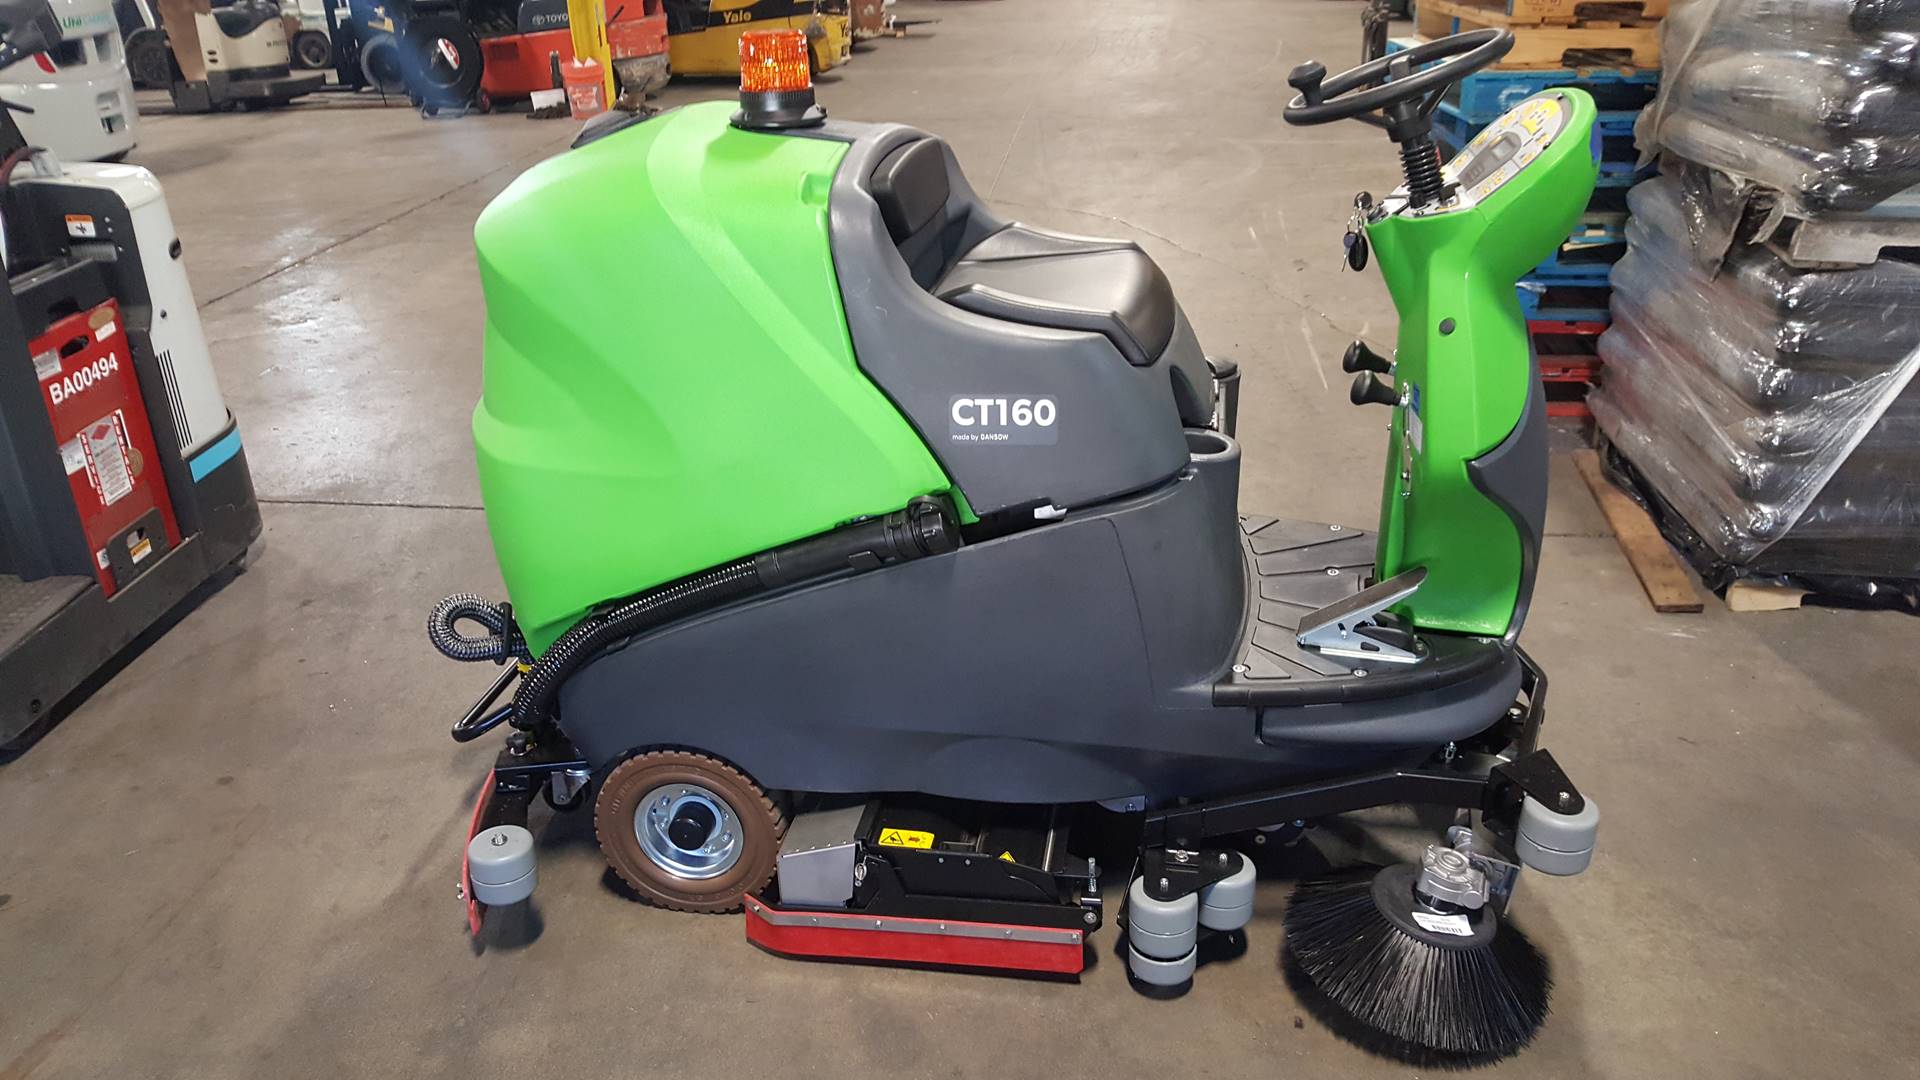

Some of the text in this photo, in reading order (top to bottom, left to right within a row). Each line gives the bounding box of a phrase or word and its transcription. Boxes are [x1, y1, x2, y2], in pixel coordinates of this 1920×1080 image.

[546, 13, 569, 23] TOYO
[723, 10, 752, 24] Yale
[49, 351, 119, 405] BA00494
[951, 398, 1056, 427] CT160
[970, 434, 979, 442] by
